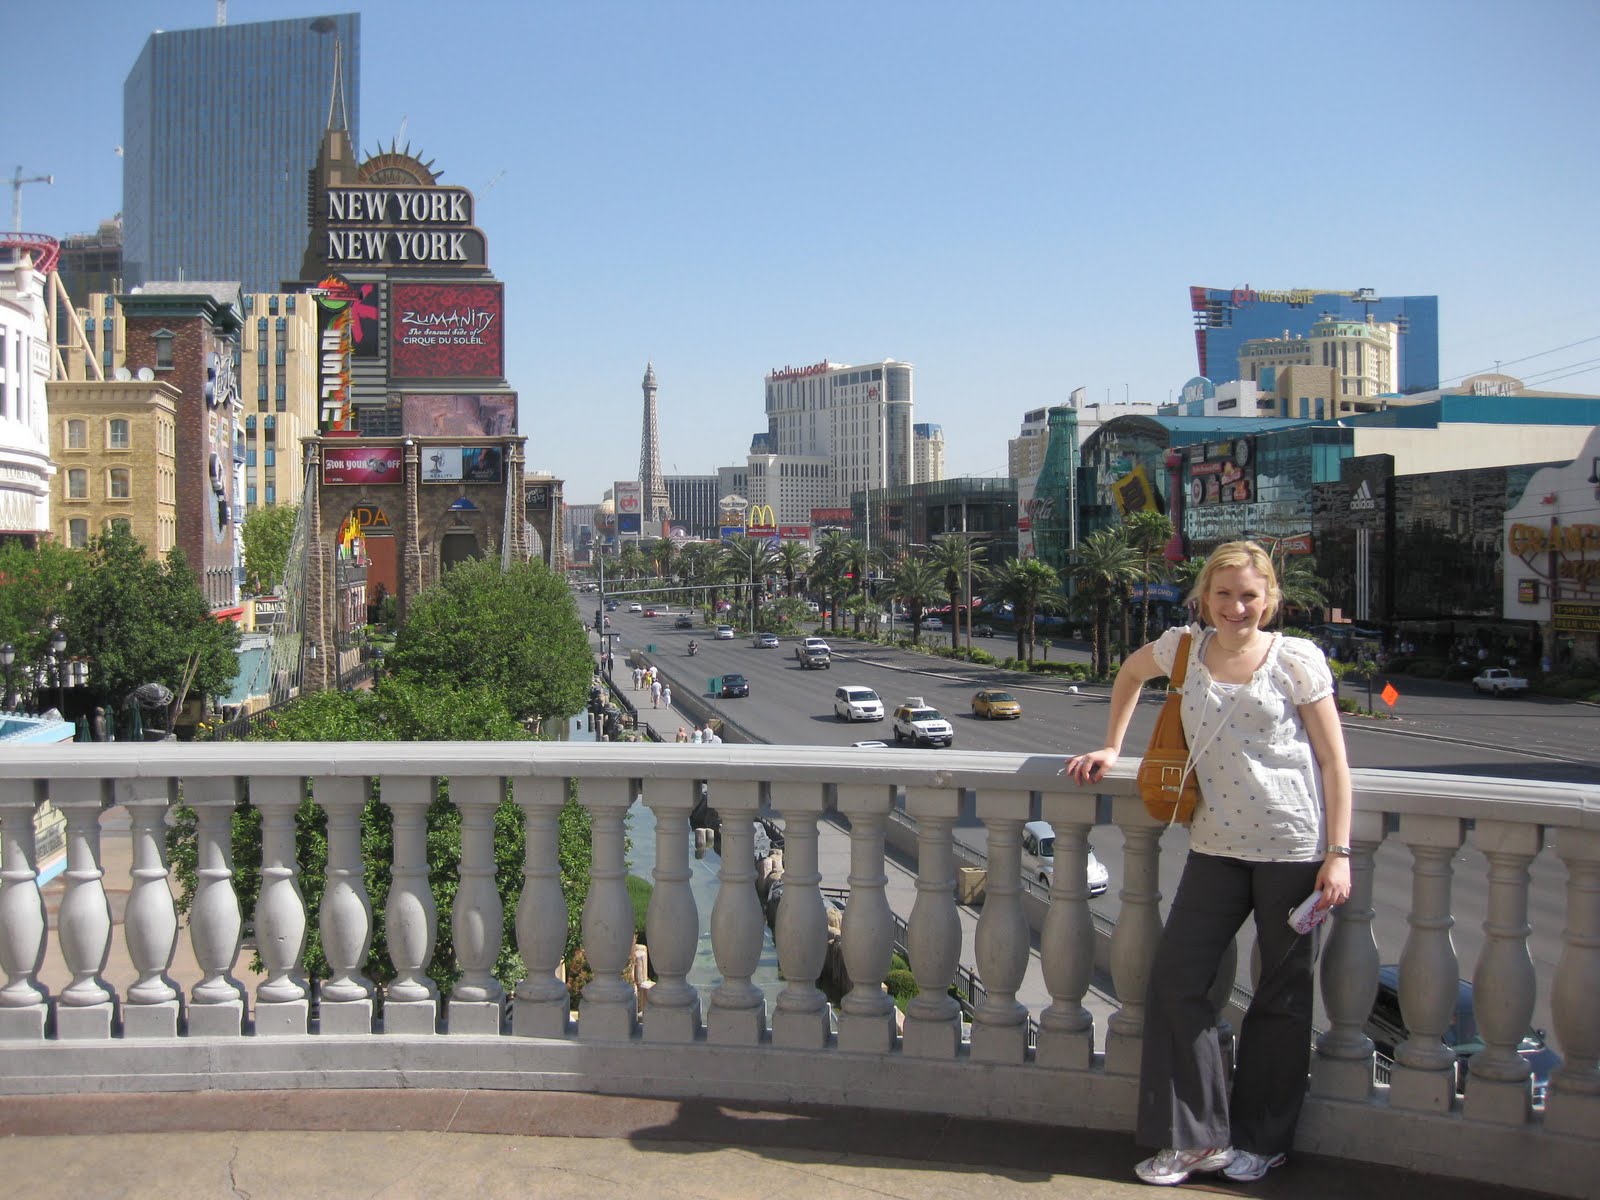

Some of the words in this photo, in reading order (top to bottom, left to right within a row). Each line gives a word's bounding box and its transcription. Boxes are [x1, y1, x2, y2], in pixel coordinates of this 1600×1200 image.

[328, 191, 389, 220] NEW
[396, 191, 468, 222] YORK
[328, 231, 388, 259] NEW
[396, 231, 468, 261] YORK
[1258, 289, 1314, 304] WESTGATE
[403, 336, 436, 347] CIRQUE
[438, 337, 452, 345] DU
[772, 359, 827, 383] hollywood
